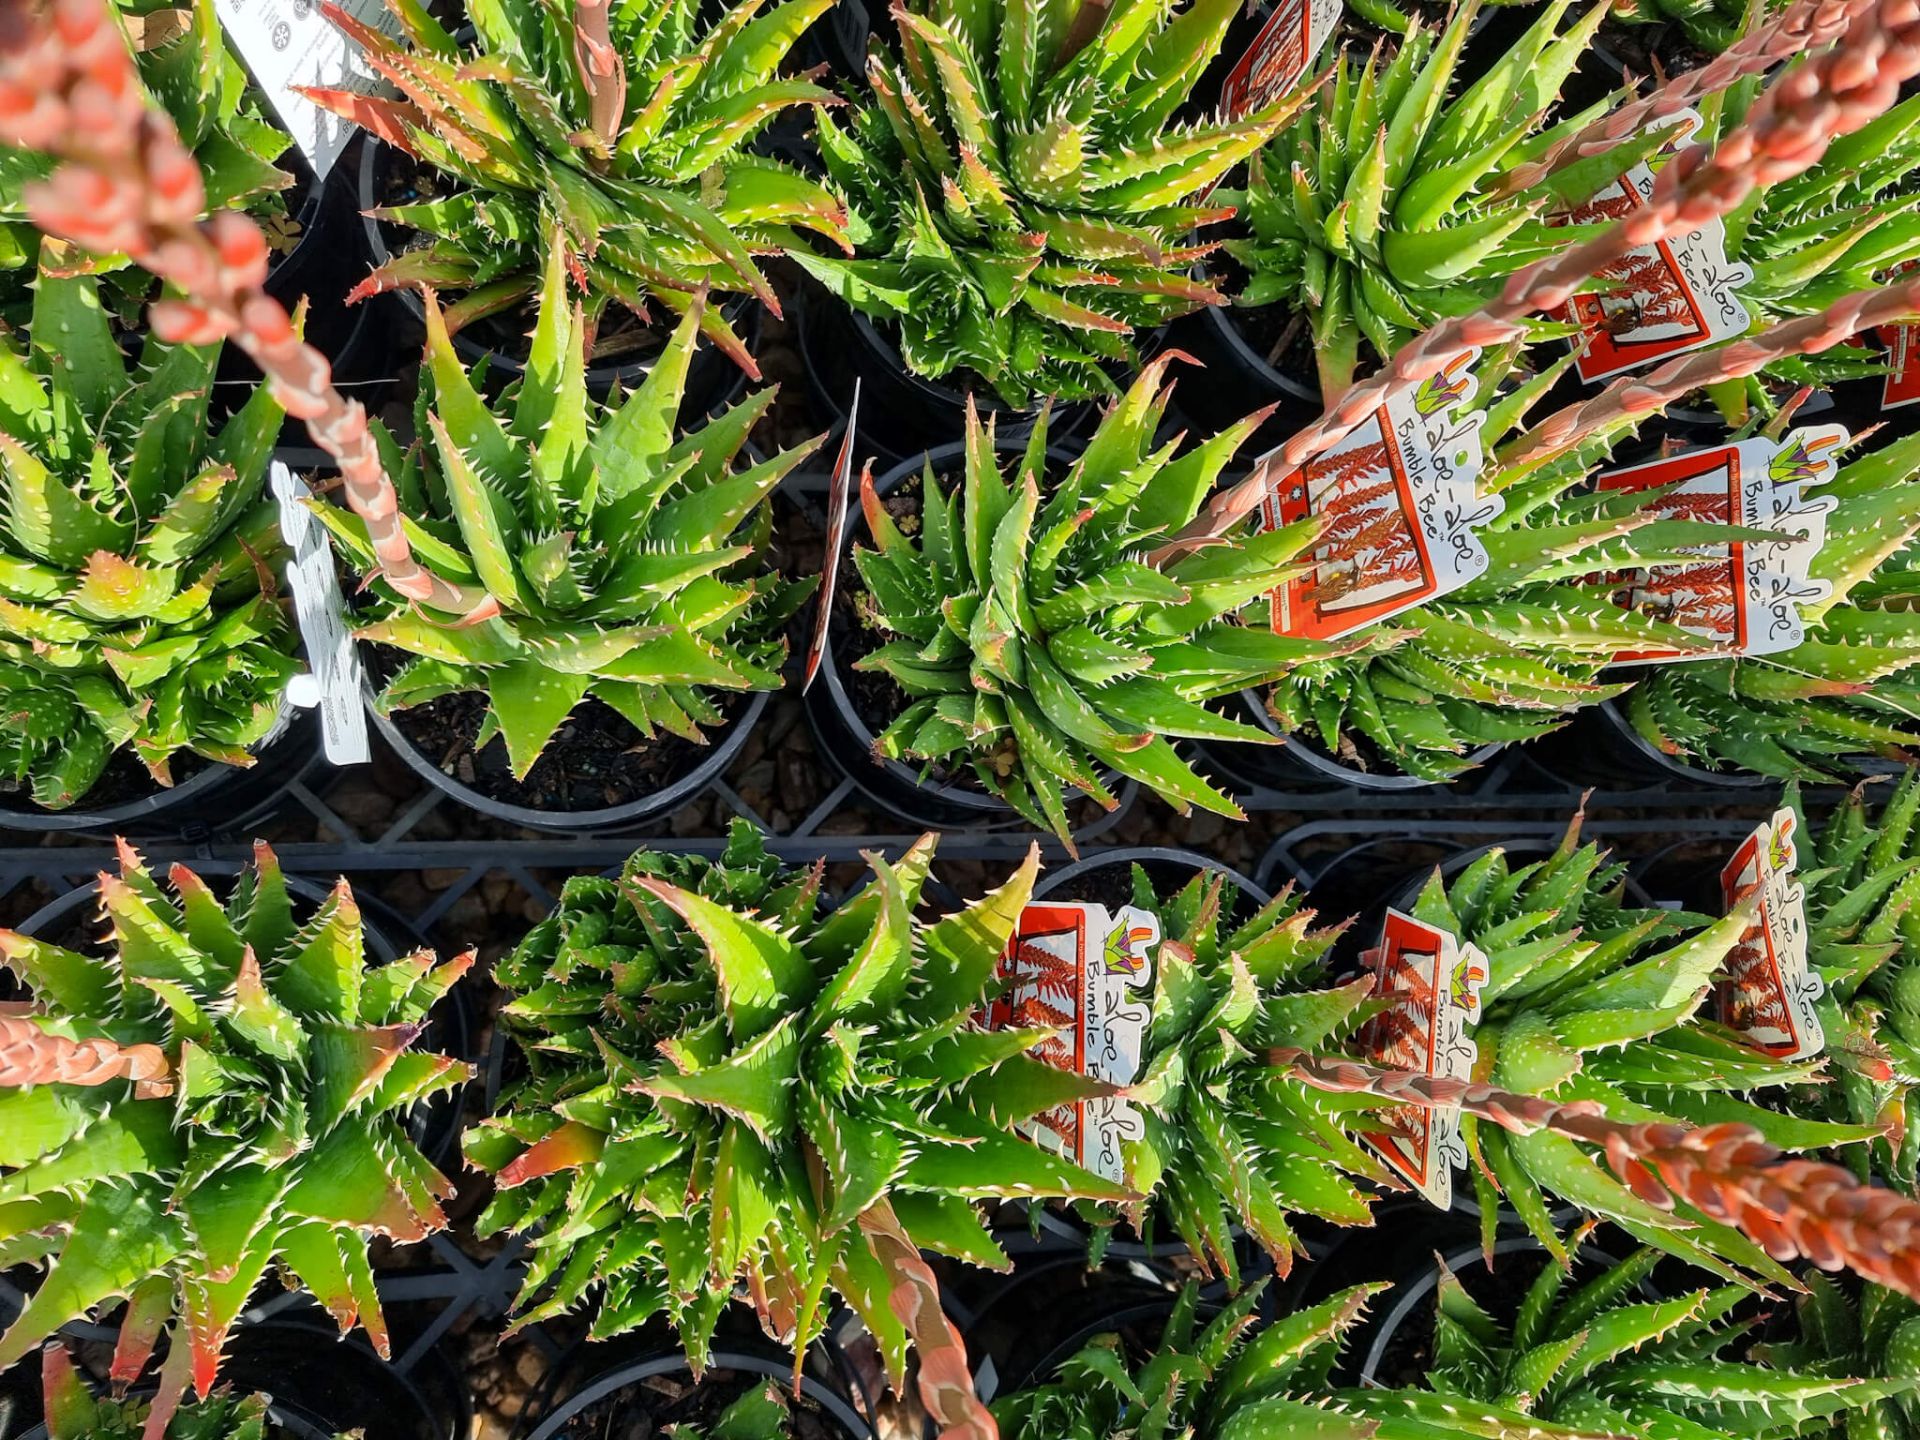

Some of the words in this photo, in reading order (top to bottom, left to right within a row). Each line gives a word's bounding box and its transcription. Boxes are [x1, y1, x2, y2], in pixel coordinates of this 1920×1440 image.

[1397, 417, 1424, 488] Bumble
[1087, 961, 1100, 1047] Bumble
[1435, 989, 1448, 1071] Bumble
